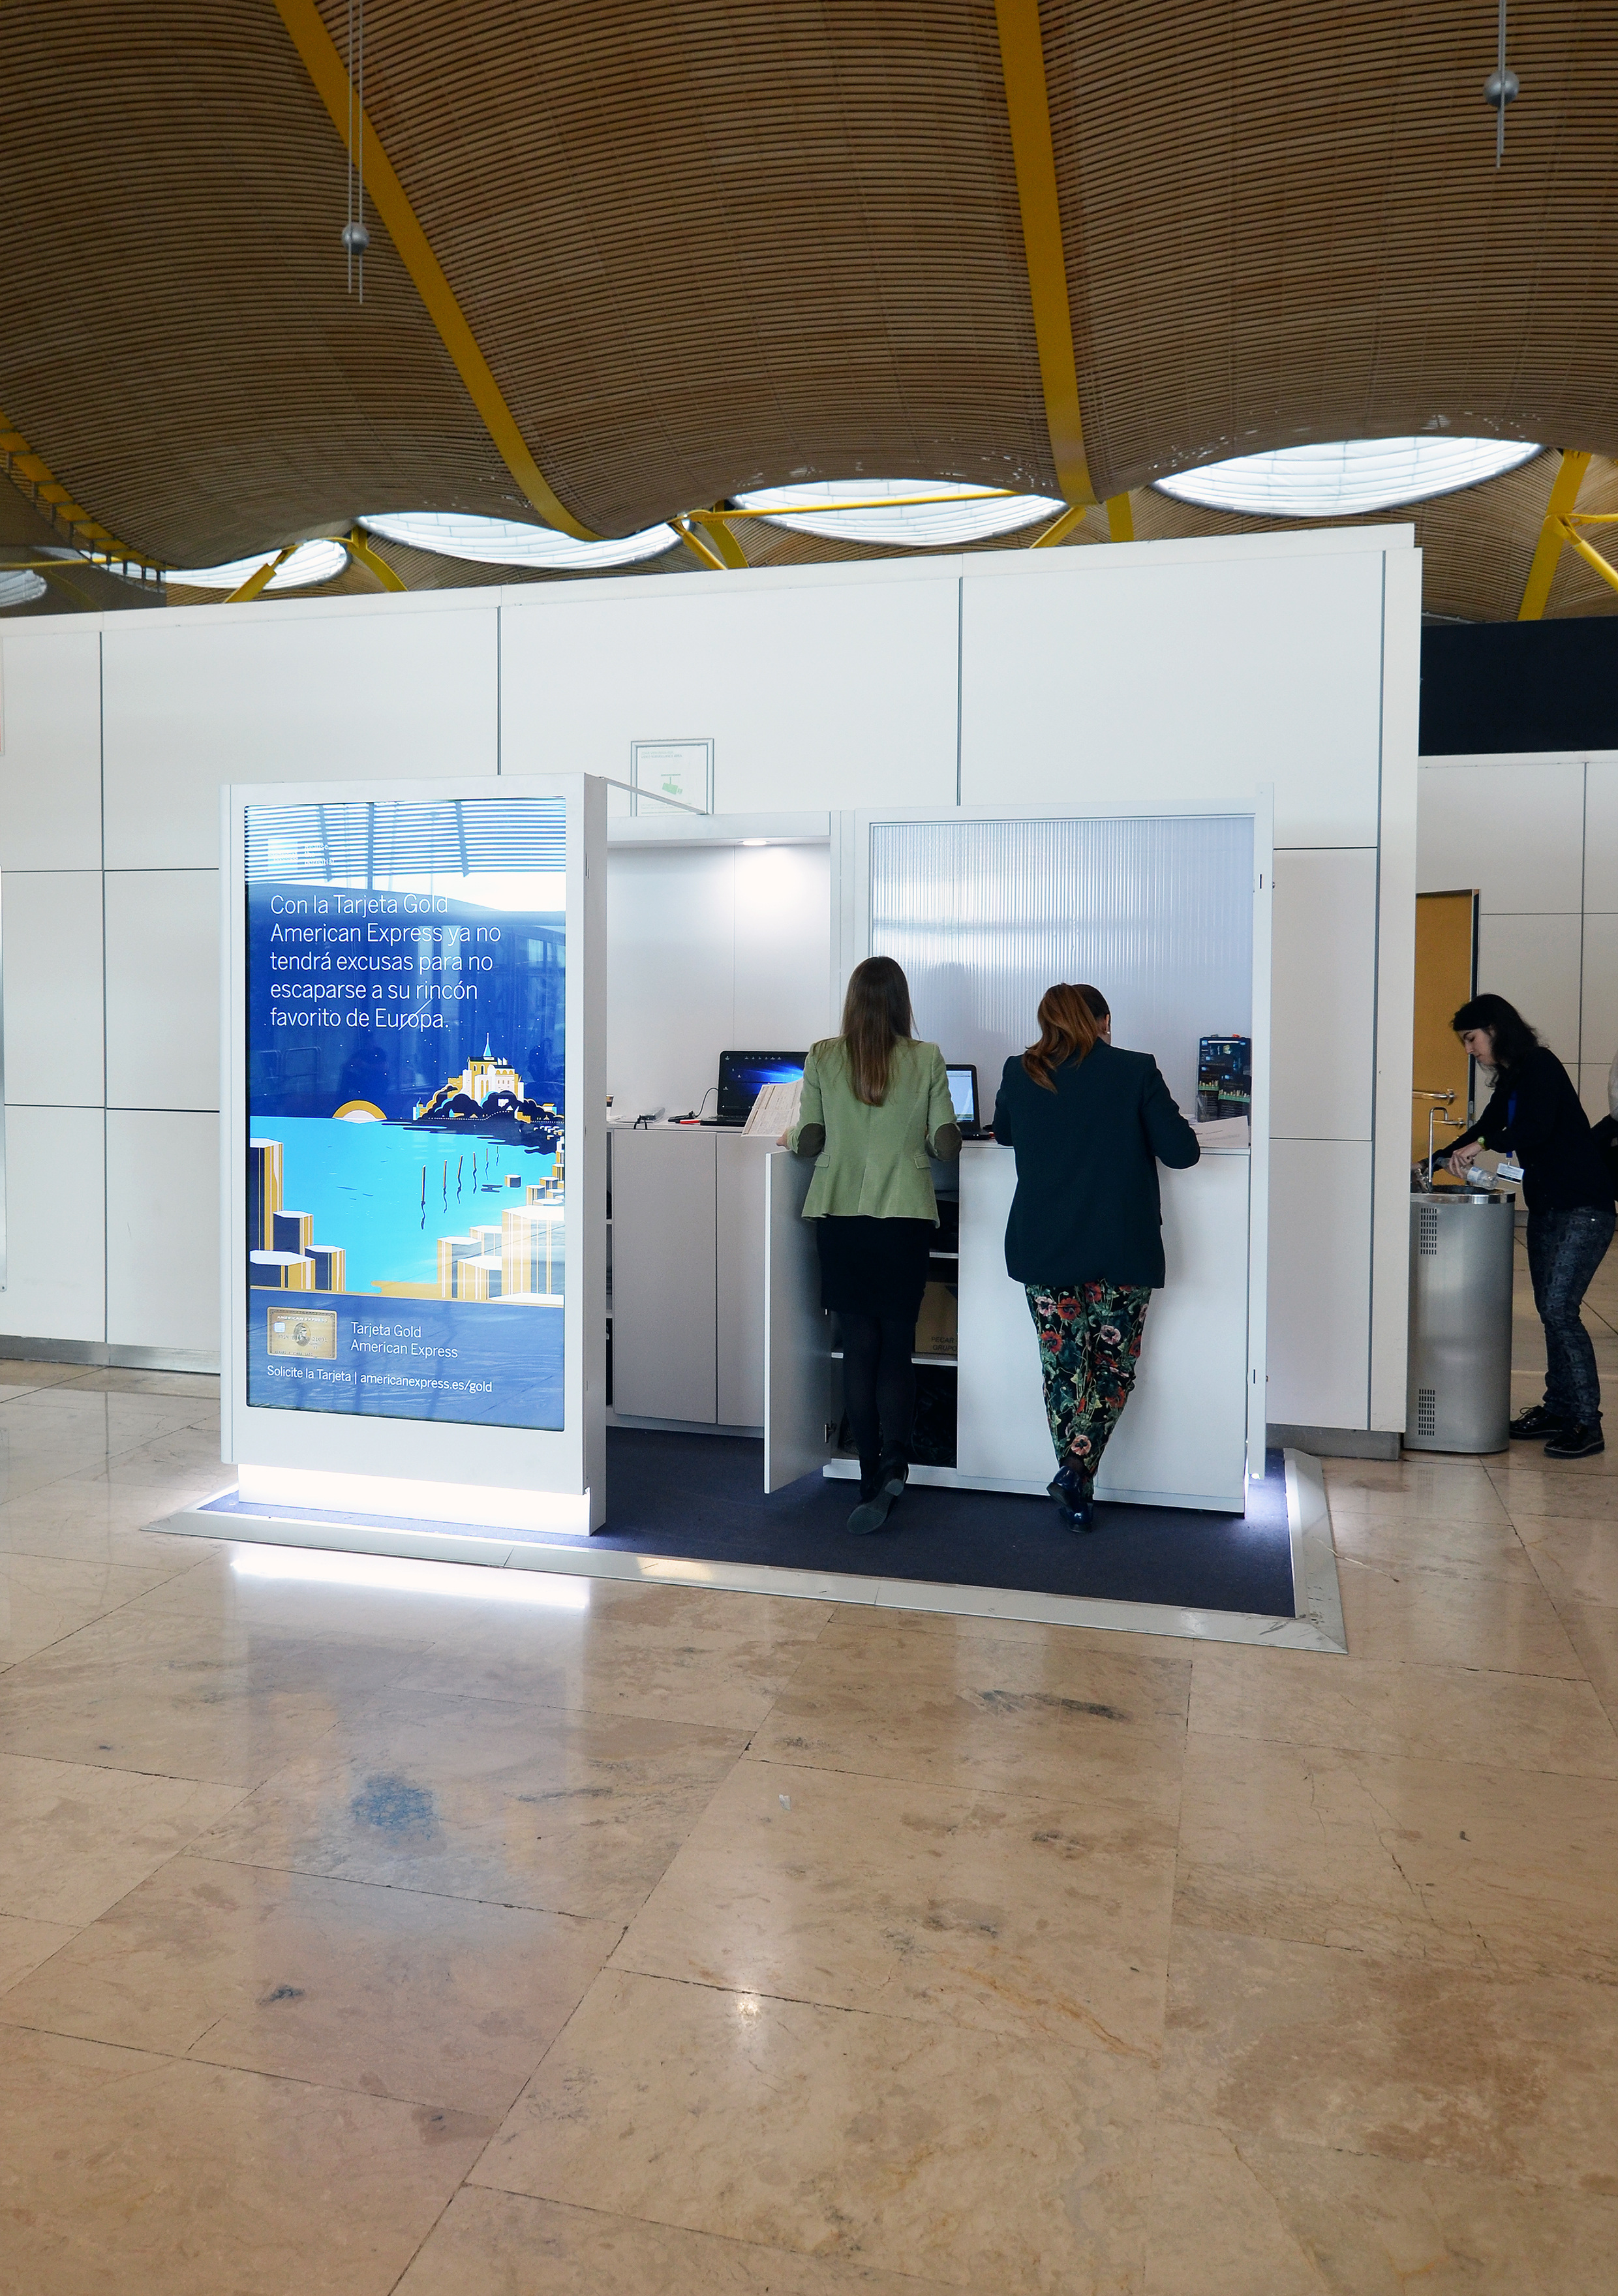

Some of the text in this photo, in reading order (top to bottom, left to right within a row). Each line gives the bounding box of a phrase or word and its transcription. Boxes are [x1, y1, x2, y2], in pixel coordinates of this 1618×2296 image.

[271, 894, 449, 918] Con la Tarjeta Gold
[270, 923, 501, 947] American Express ya no
[270, 951, 493, 975] tendrá excusas para no
[270, 980, 478, 1003] escaparse a su rincón
[269, 1007, 450, 1032] favorito de Europa.
[350, 1321, 421, 1338] Tarjeta Gold
[350, 1339, 458, 1359] American Express
[267, 1365, 303, 1378] Solicite
[305, 1368, 314, 1379] la
[316, 1368, 352, 1383] Tarjeta
[360, 1374, 493, 1394] americanexpress.es/gold
